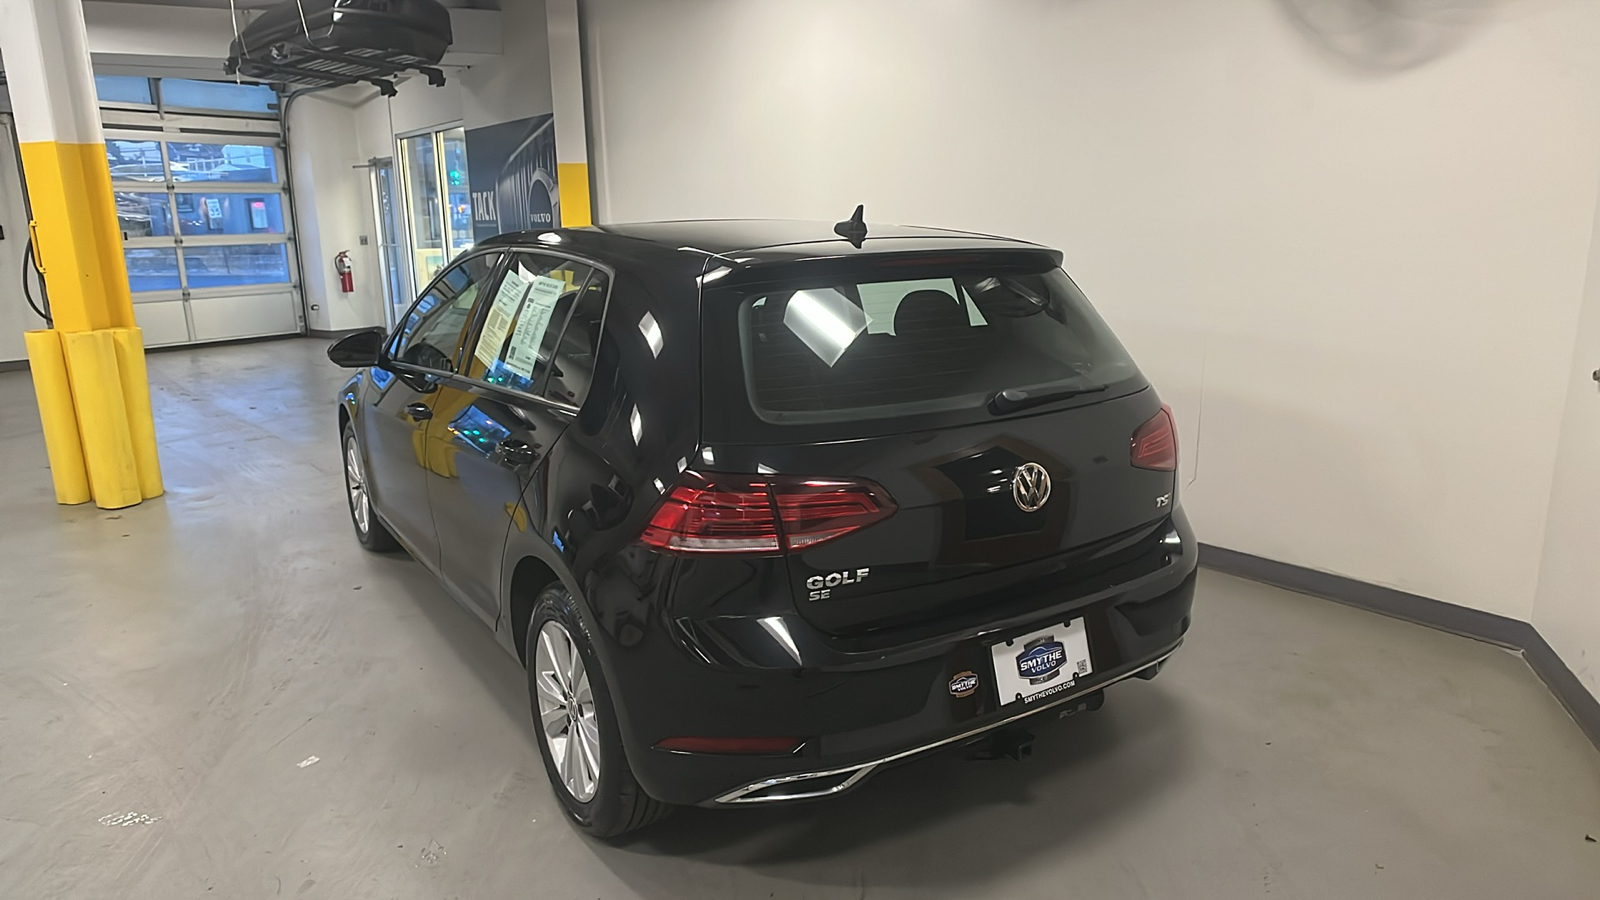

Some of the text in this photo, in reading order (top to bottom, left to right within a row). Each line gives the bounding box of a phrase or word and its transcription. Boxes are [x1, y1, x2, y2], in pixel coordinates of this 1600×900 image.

[472, 190, 496, 221] TACK
[530, 212, 551, 223] VOLVO
[806, 567, 870, 590] GOLF
[808, 588, 831, 602] SE
[1020, 650, 1063, 671] SMYTHE
[1031, 660, 1057, 673] VOLVO
[951, 679, 976, 691] SMYTHE
[1023, 680, 1076, 704] SMYTHEVOLVO.COM
